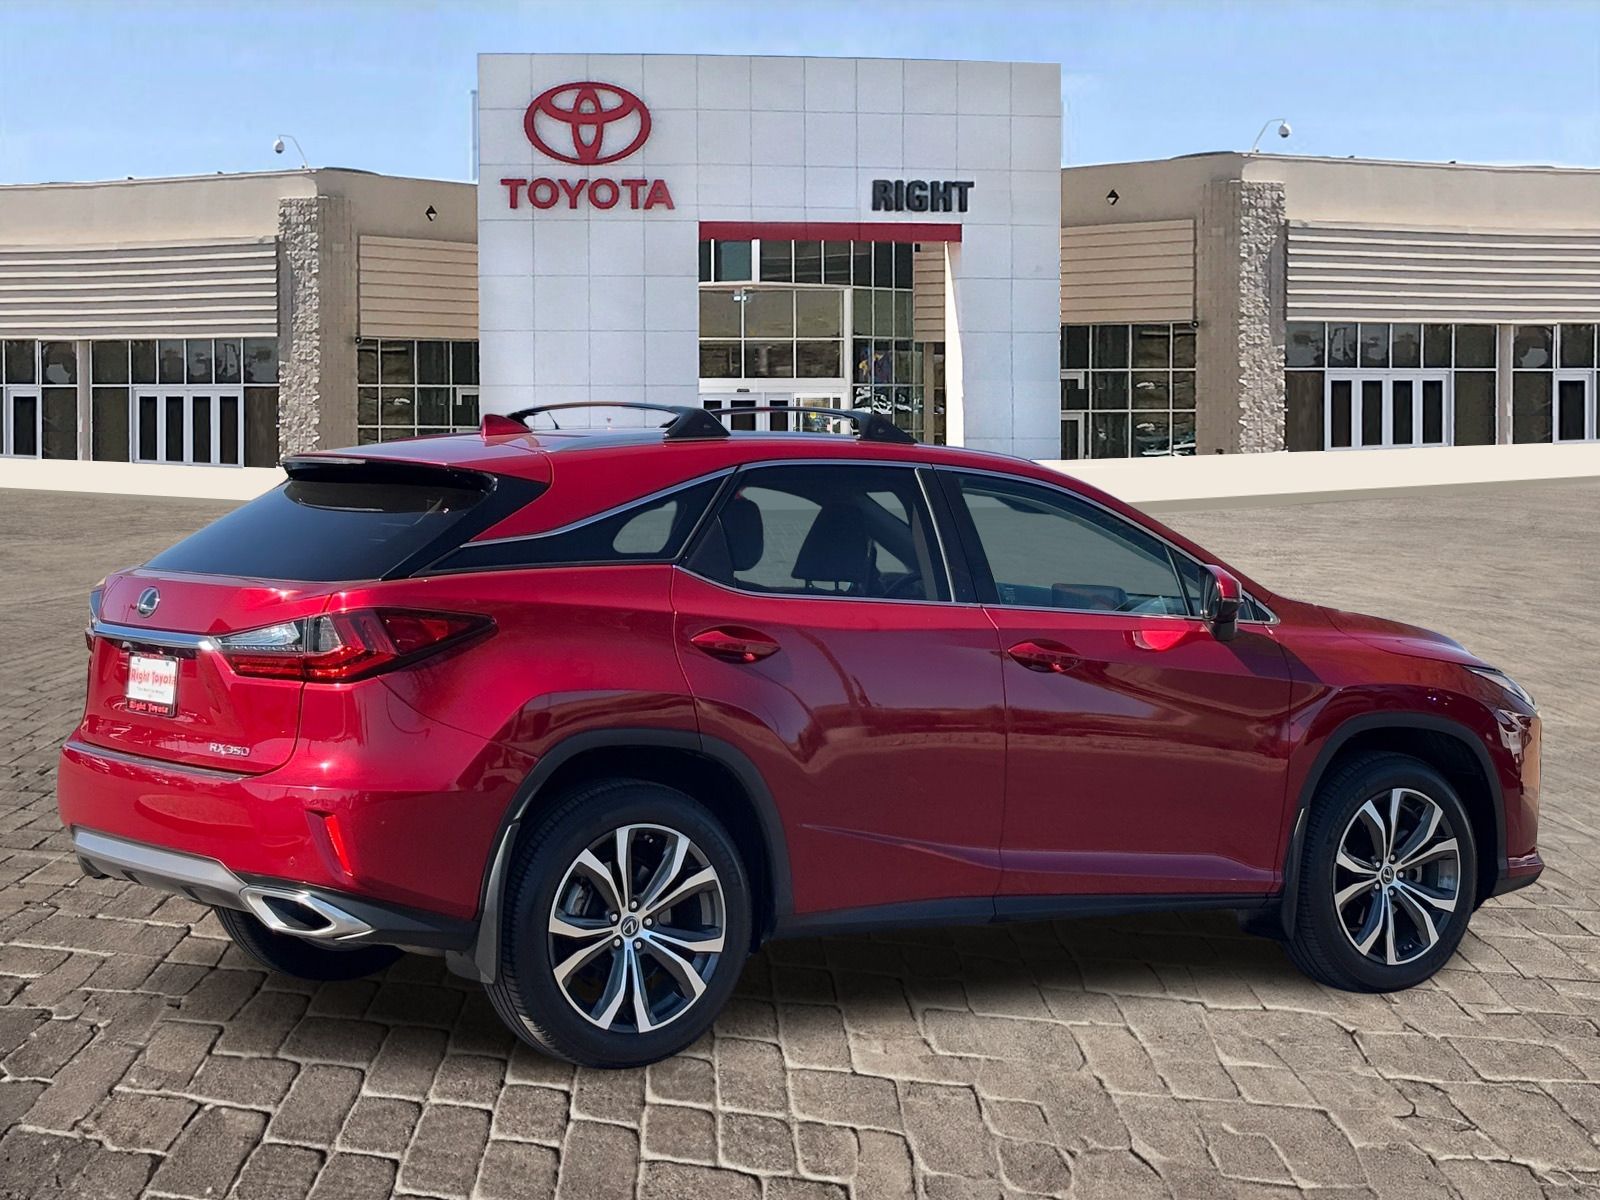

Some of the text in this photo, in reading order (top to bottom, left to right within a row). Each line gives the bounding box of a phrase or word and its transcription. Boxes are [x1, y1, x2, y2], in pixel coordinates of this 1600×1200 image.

[501, 178, 675, 210] TOYOTA
[872, 180, 975, 212] RIGHT
[130, 668, 150, 685] Right
